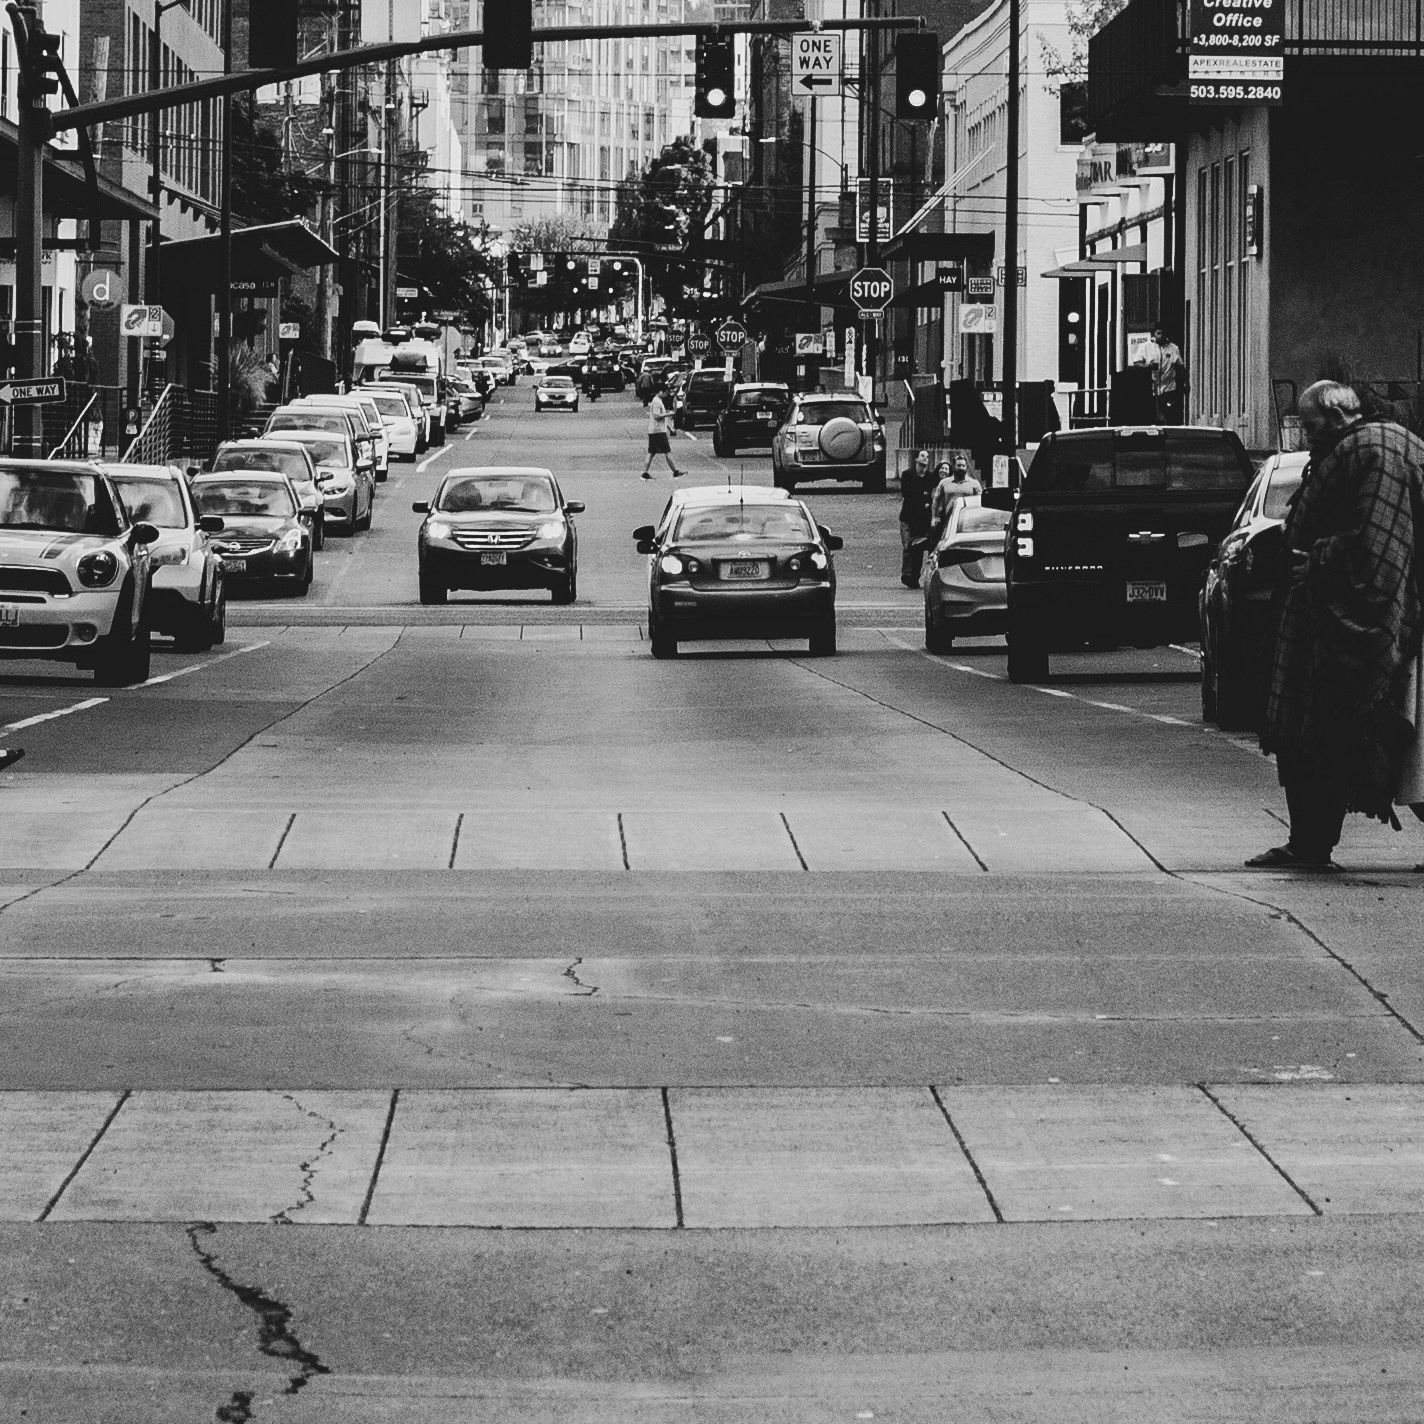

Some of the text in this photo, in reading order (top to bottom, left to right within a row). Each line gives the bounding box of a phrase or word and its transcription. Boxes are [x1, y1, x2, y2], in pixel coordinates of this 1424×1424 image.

[1213, 13, 1263, 28] Office
[800, 39, 832, 53] ONE
[1264, 35, 1280, 47] SF
[799, 56, 833, 70] WAY
[1190, 85, 1281, 99] 503.595.2840
[853, 281, 890, 297] STOP
[720, 330, 745, 343] STOP
[689, 339, 709, 350] STOP
[12, 384, 58, 398] ONE WAY
